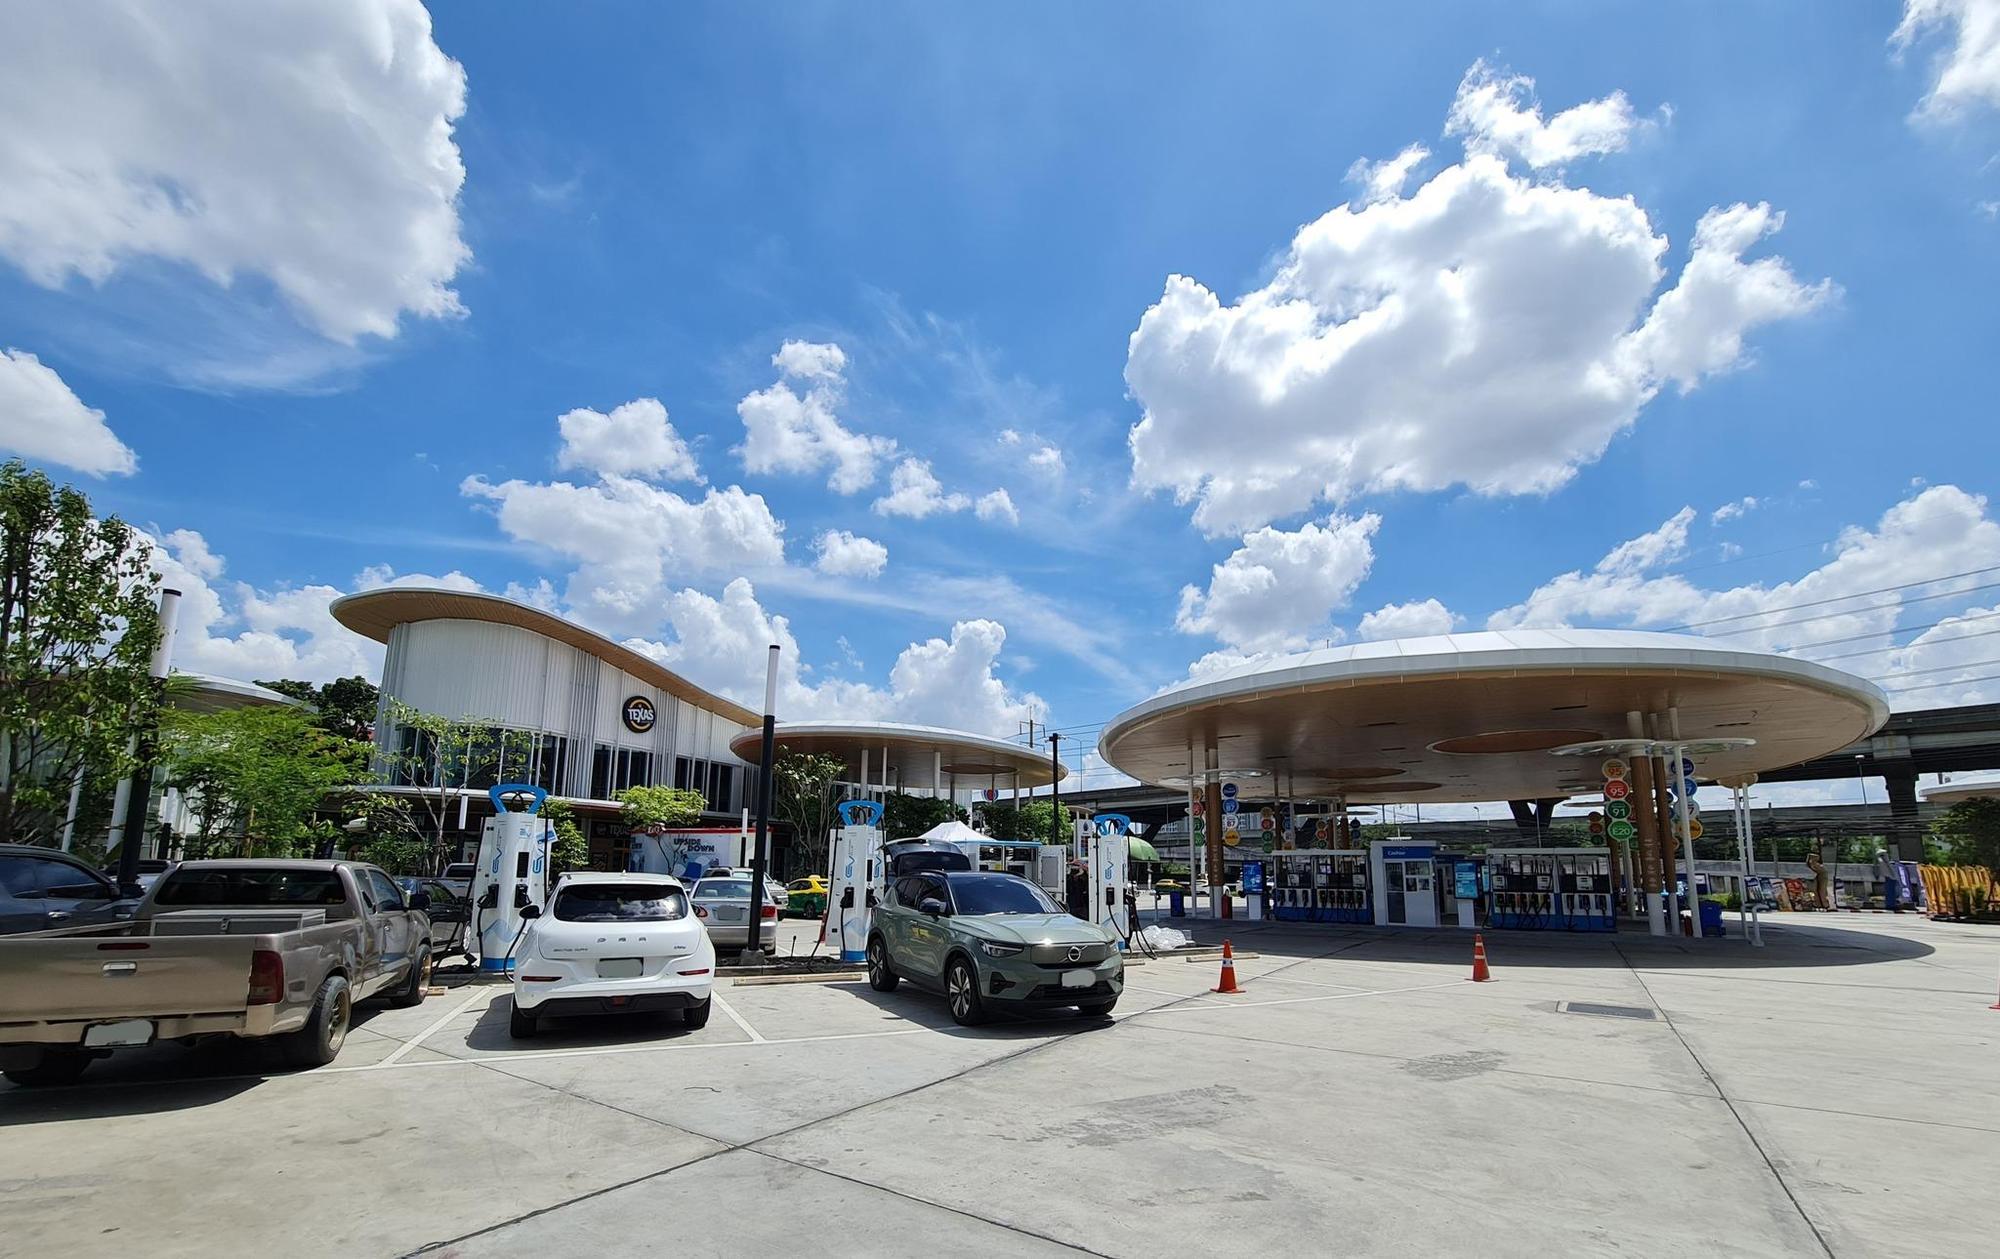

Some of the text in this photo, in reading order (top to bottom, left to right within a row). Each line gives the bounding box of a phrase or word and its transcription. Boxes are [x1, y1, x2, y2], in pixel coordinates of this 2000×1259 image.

[628, 708, 654, 723] TEXAS
[1610, 788, 1625, 796] 95
[1612, 808, 1626, 817] 91
[1612, 826, 1630, 836] E20
[673, 838, 702, 846] UPSIDE
[687, 844, 715, 853] DOWN
